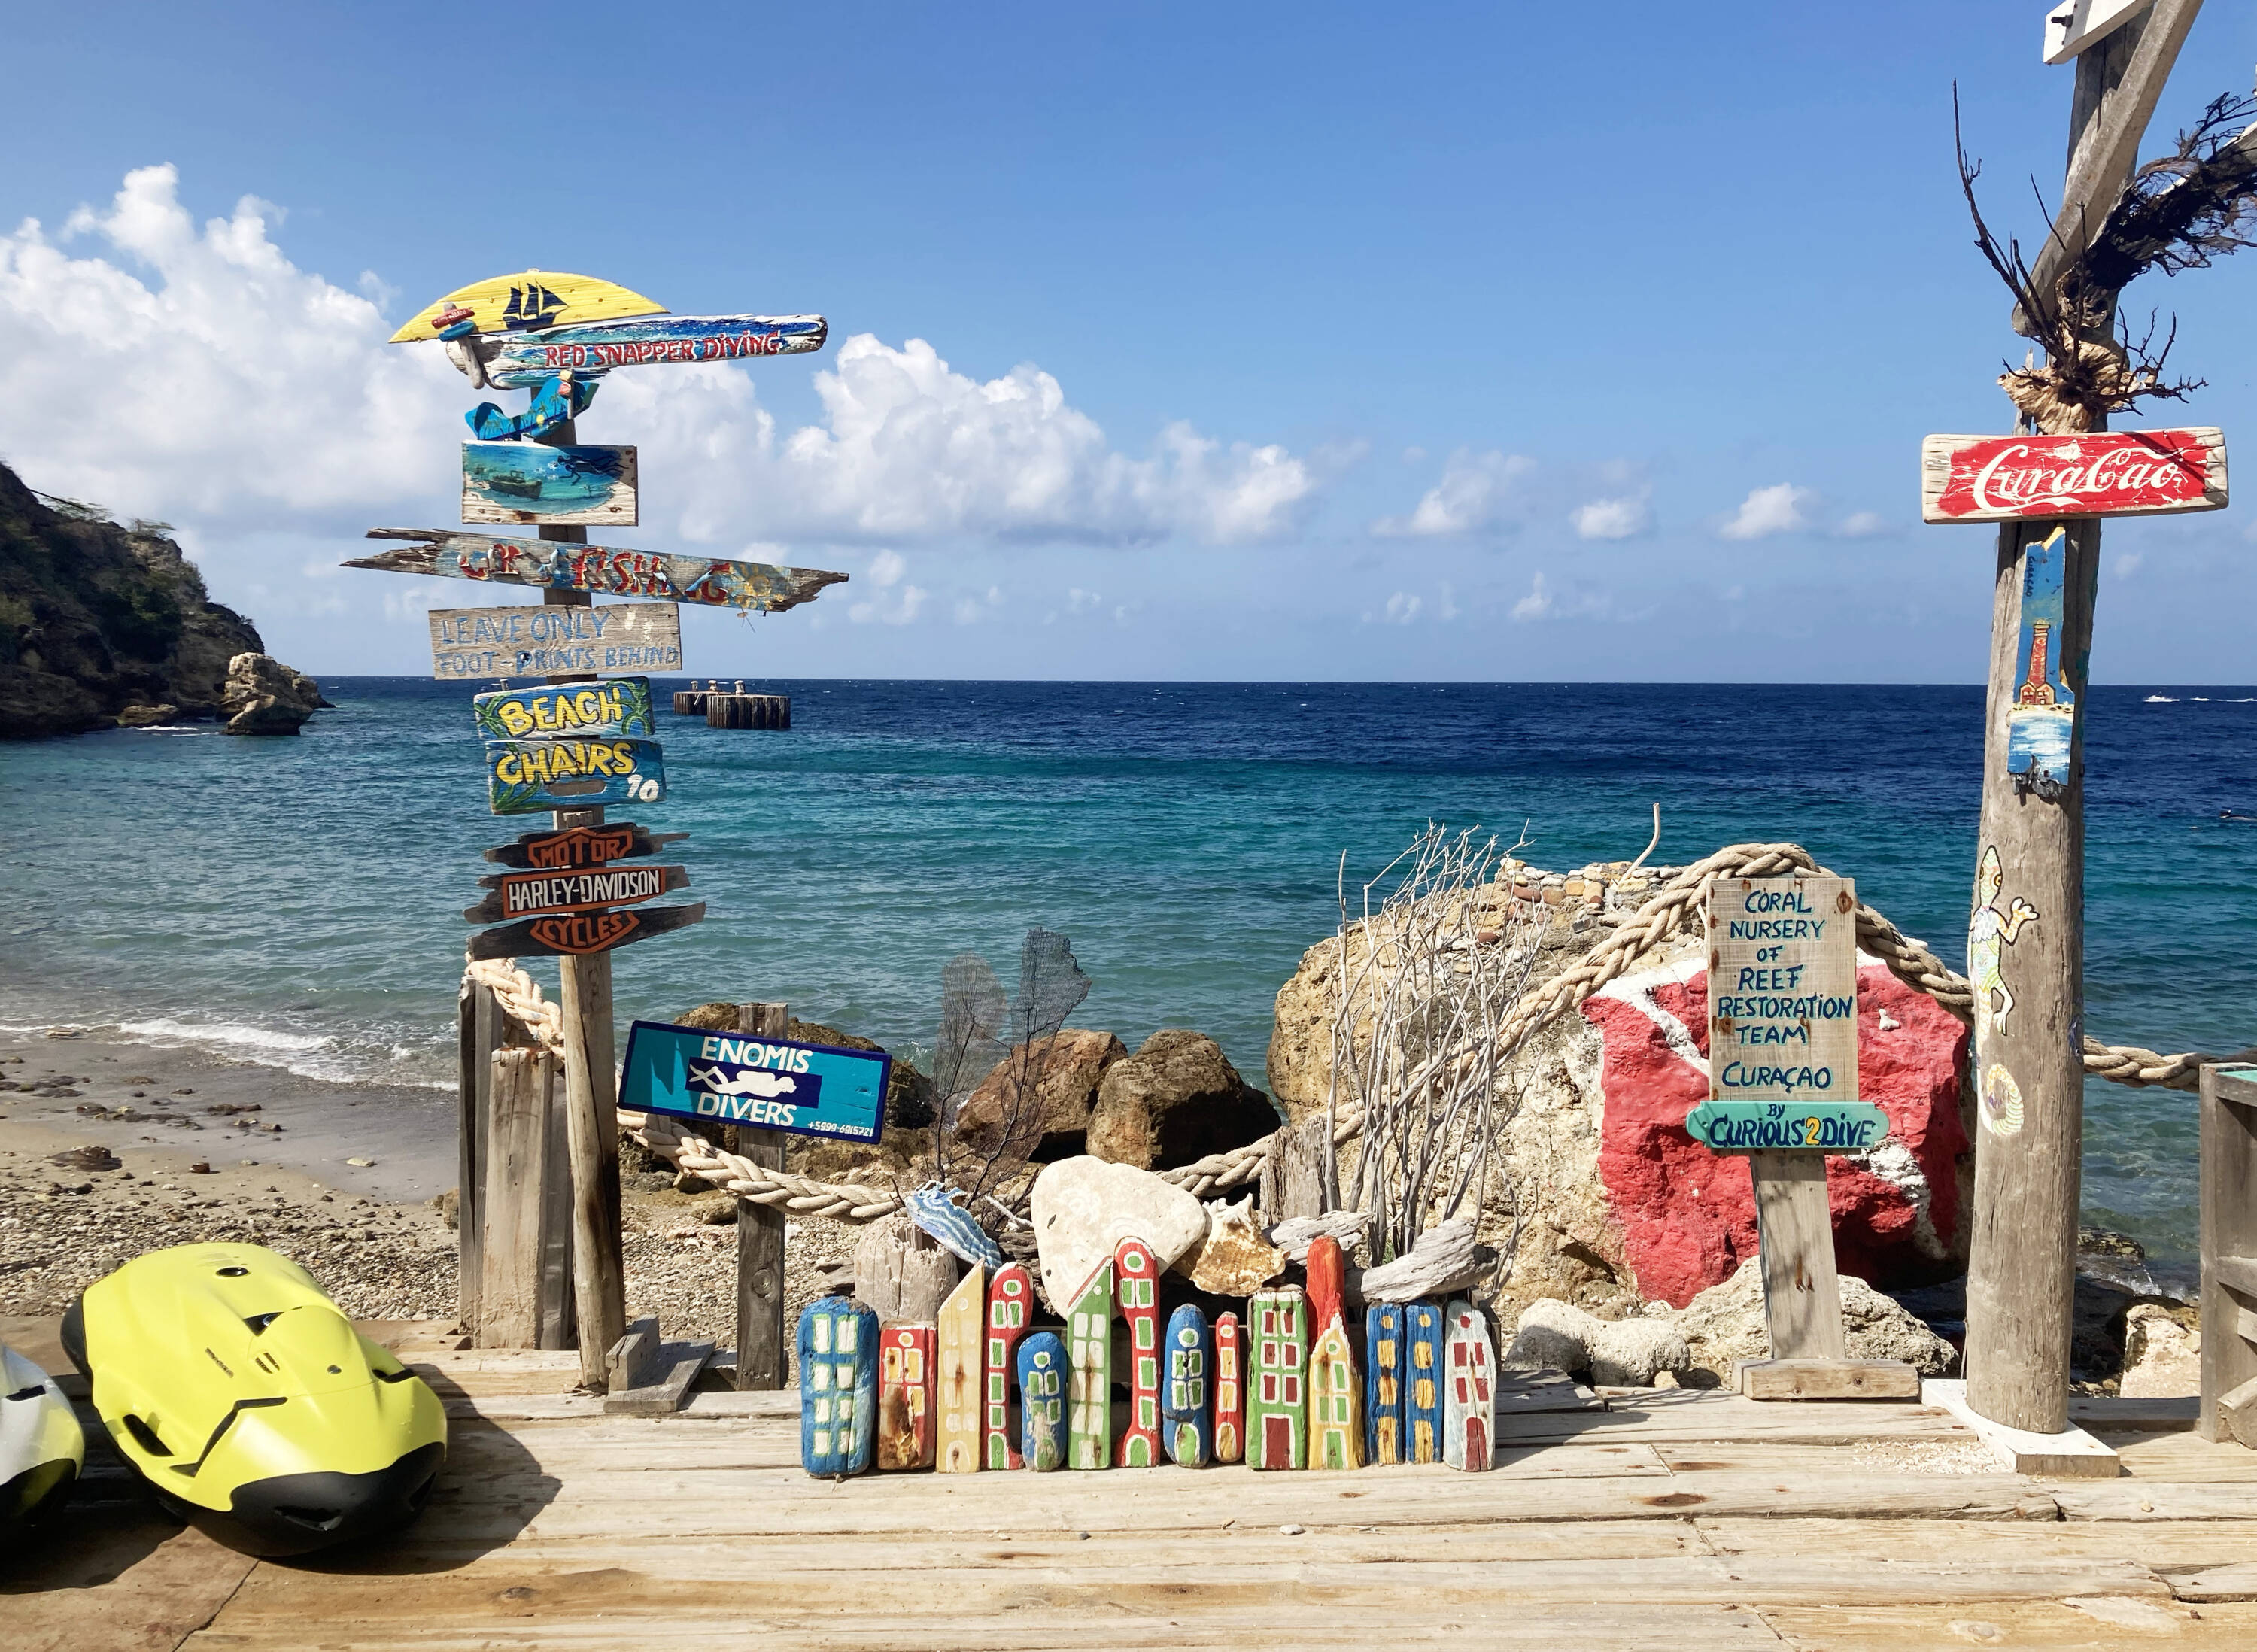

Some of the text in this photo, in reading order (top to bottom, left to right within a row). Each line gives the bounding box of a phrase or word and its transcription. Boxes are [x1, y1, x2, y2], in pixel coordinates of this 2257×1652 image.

[545, 345, 585, 367] RED
[593, 339, 697, 366] SNAPPER
[441, 611, 611, 645] LEAVE ONLY
[604, 645, 677, 667] BEHIND
[497, 687, 624, 738] BEACH
[496, 742, 636, 785] CHAIRS
[541, 834, 620, 867] MOTOR
[508, 869, 660, 911] HARLEY-DAVIDSON
[1745, 890, 1813, 914] CORAL
[542, 915, 624, 946] CYCLES
[1730, 919, 1826, 940] NURSERY
[1757, 945, 1784, 962] OF
[1738, 964, 1805, 992] REEF
[1736, 1025, 1806, 1044] TEAM
[700, 1036, 813, 1073] ENOMIS
[1721, 1061, 1833, 1094] CURAÇAO
[697, 1092, 797, 1127] DIVERS
[1766, 1104, 1786, 1120] BY
[807, 1121, 874, 1137] +5999-6915721
